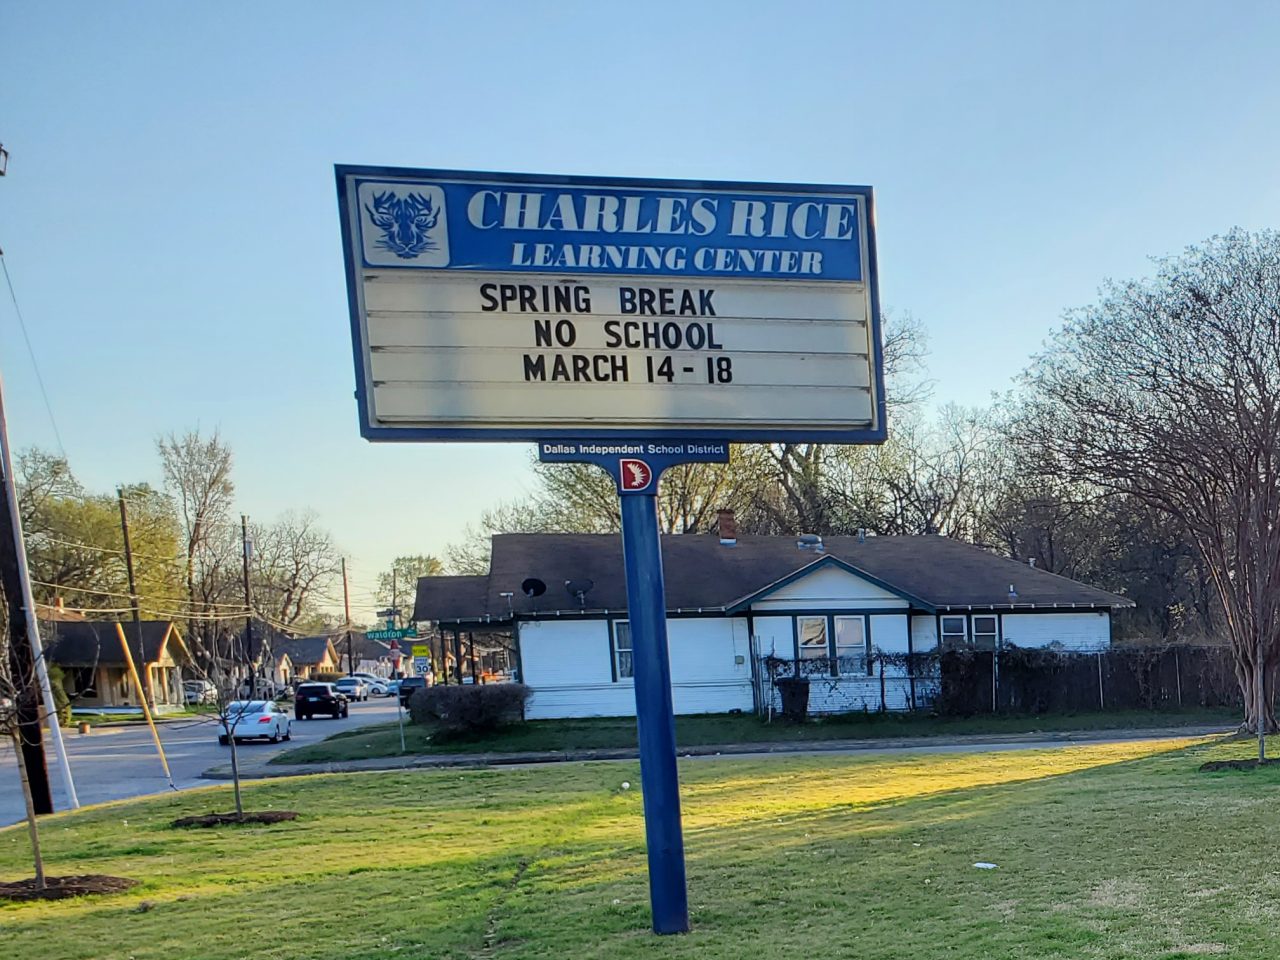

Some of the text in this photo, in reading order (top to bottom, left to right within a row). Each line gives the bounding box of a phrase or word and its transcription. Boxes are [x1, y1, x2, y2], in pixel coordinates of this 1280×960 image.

[467, 190, 855, 240] CHARLES RICE
[511, 243, 823, 275] LEARNING CENTER
[480, 283, 716, 316] SPRING BREAK
[534, 319, 723, 350] NO SCHOOL
[523, 354, 629, 382] MARCH
[646, 355, 674, 383] 14
[707, 356, 733, 384] 18
[543, 444, 725, 456] Dallas Independent School District
[416, 665, 429, 673] 30
